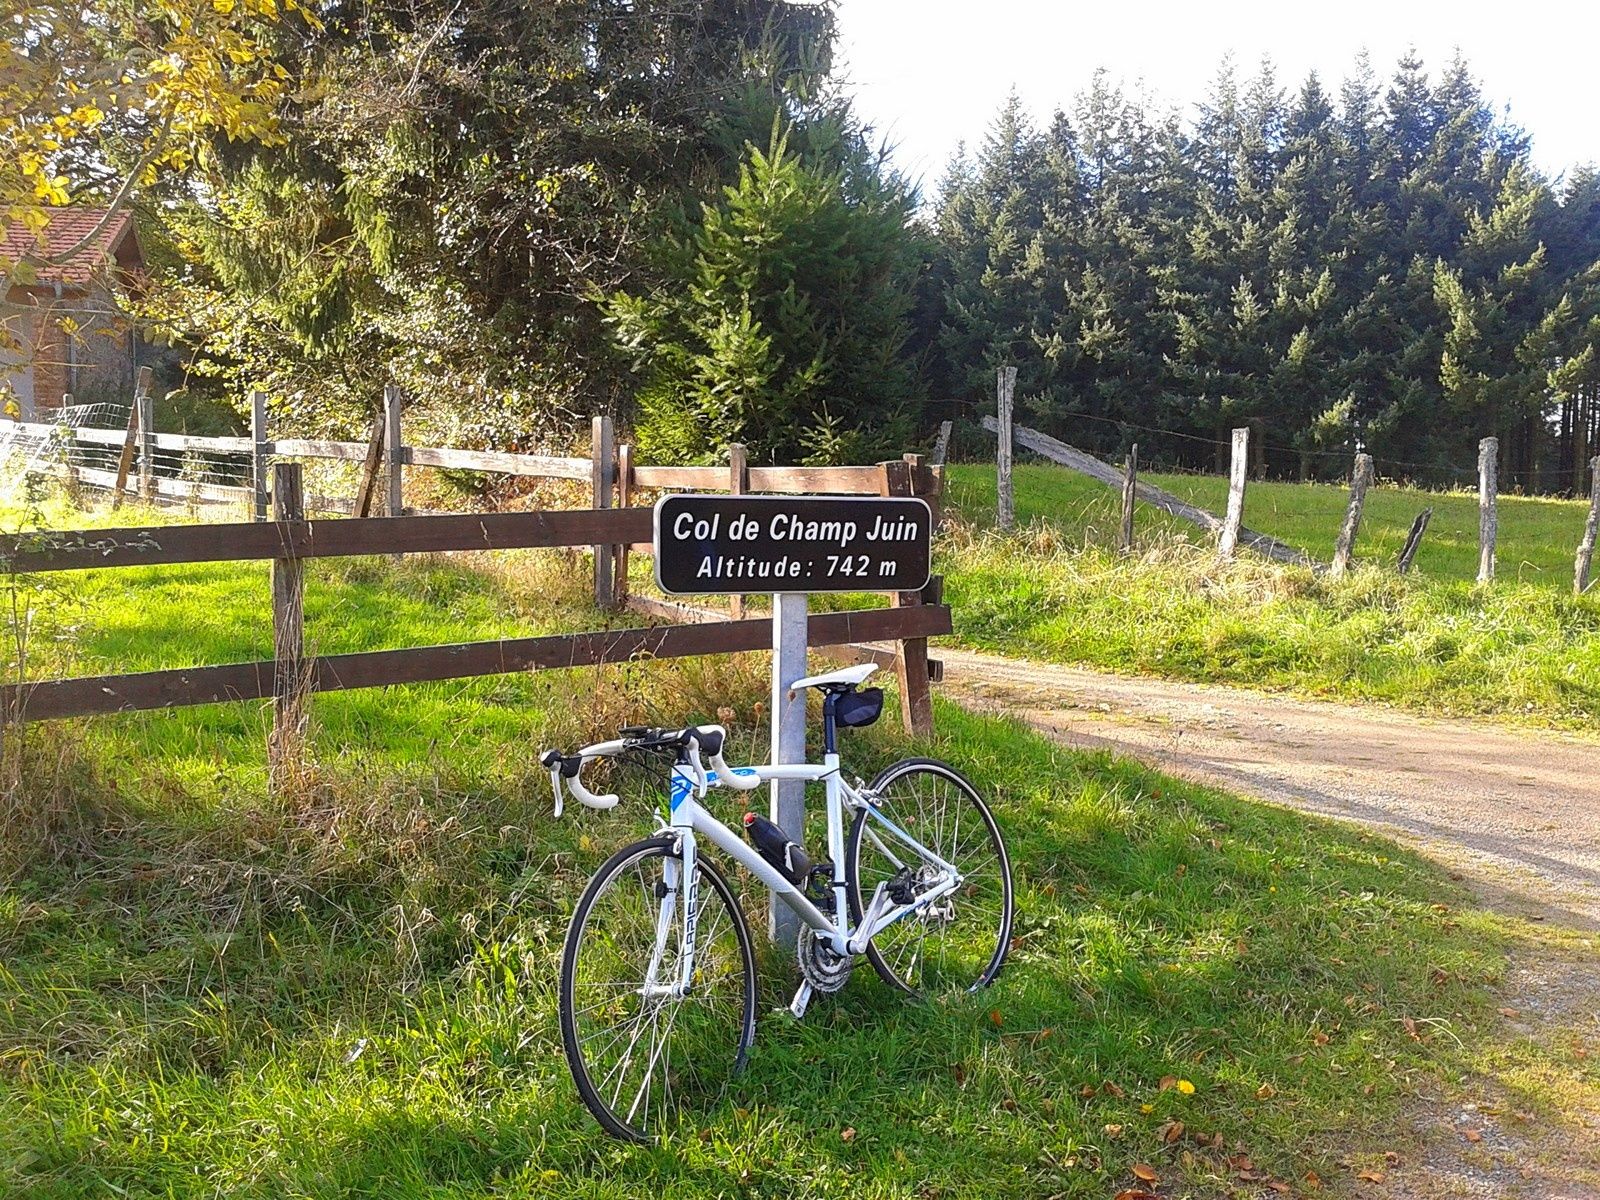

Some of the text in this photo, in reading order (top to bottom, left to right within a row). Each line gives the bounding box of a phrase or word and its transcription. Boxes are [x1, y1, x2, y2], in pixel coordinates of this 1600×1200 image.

[673, 512, 918, 548] Col de Champ Juin
[696, 554, 897, 578] Altitude: 742 m
